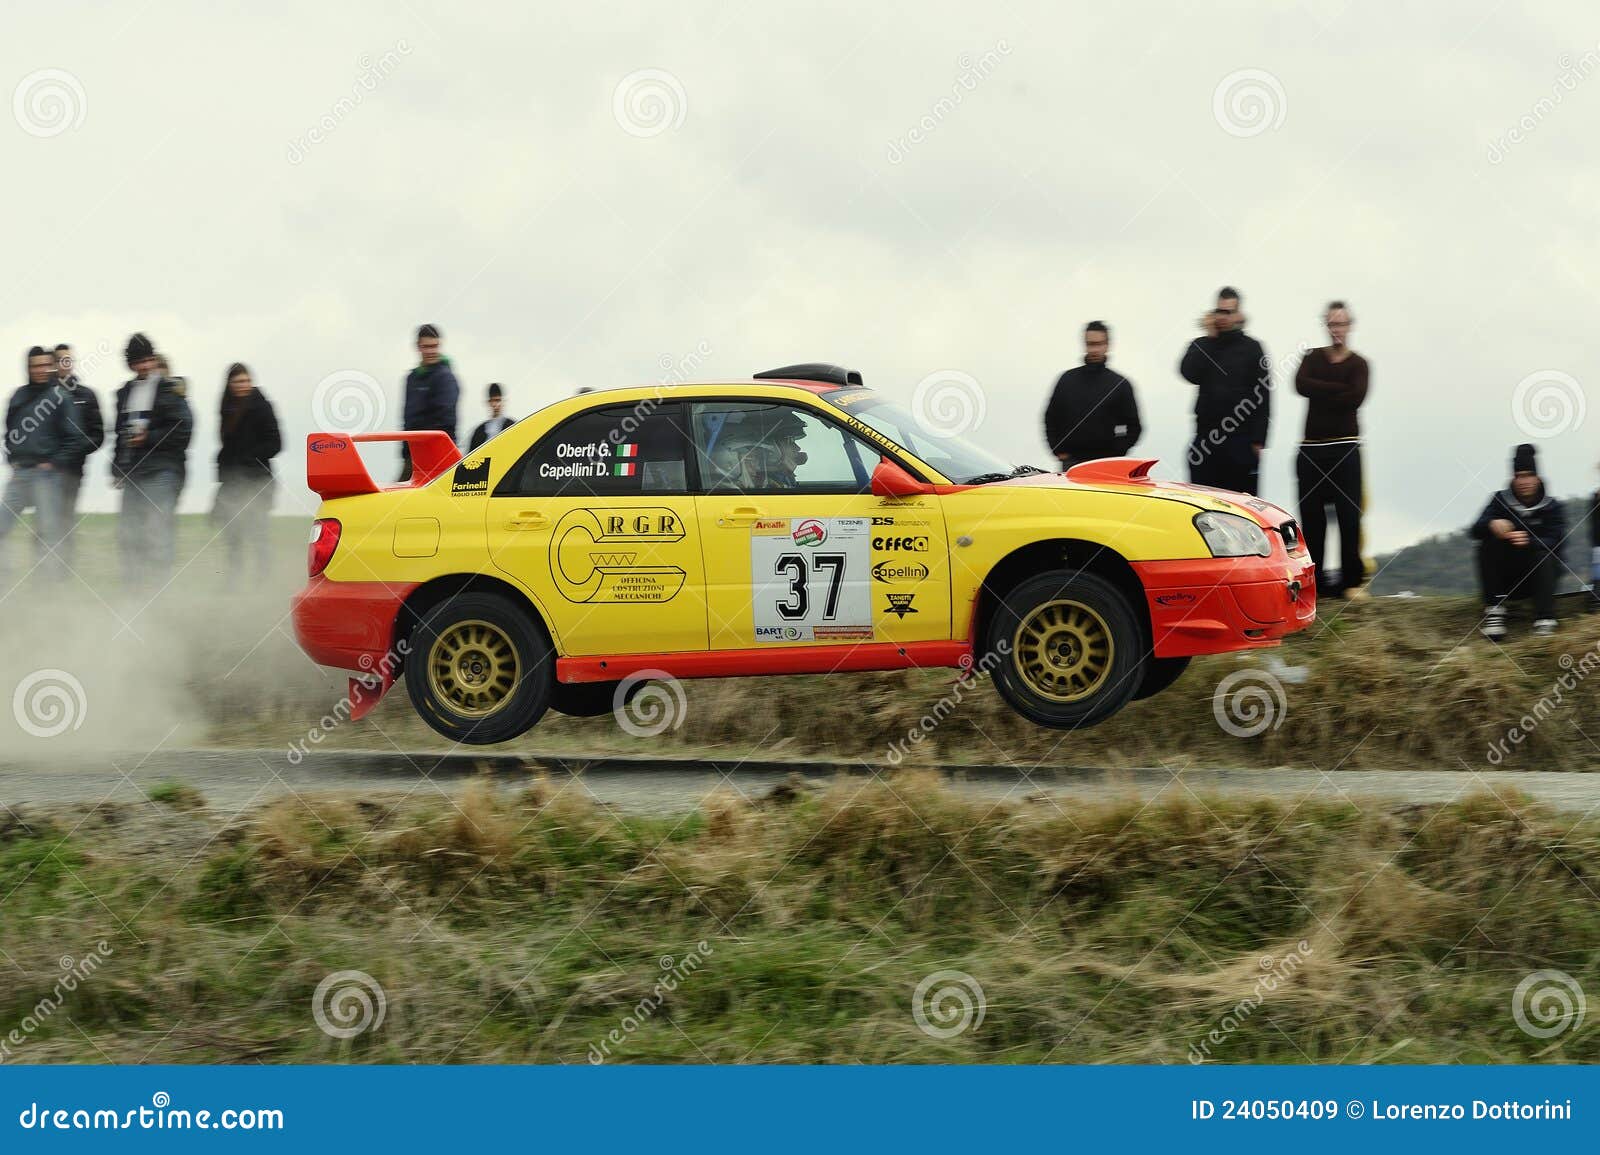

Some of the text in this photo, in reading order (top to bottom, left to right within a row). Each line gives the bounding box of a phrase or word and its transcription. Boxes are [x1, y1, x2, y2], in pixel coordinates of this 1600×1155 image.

[556, 442, 612, 457] Oberti G.
[540, 463, 610, 480] Capellini D.
[452, 481, 488, 490] Farinelli
[775, 552, 846, 621] 37
[756, 627, 783, 635] BART
